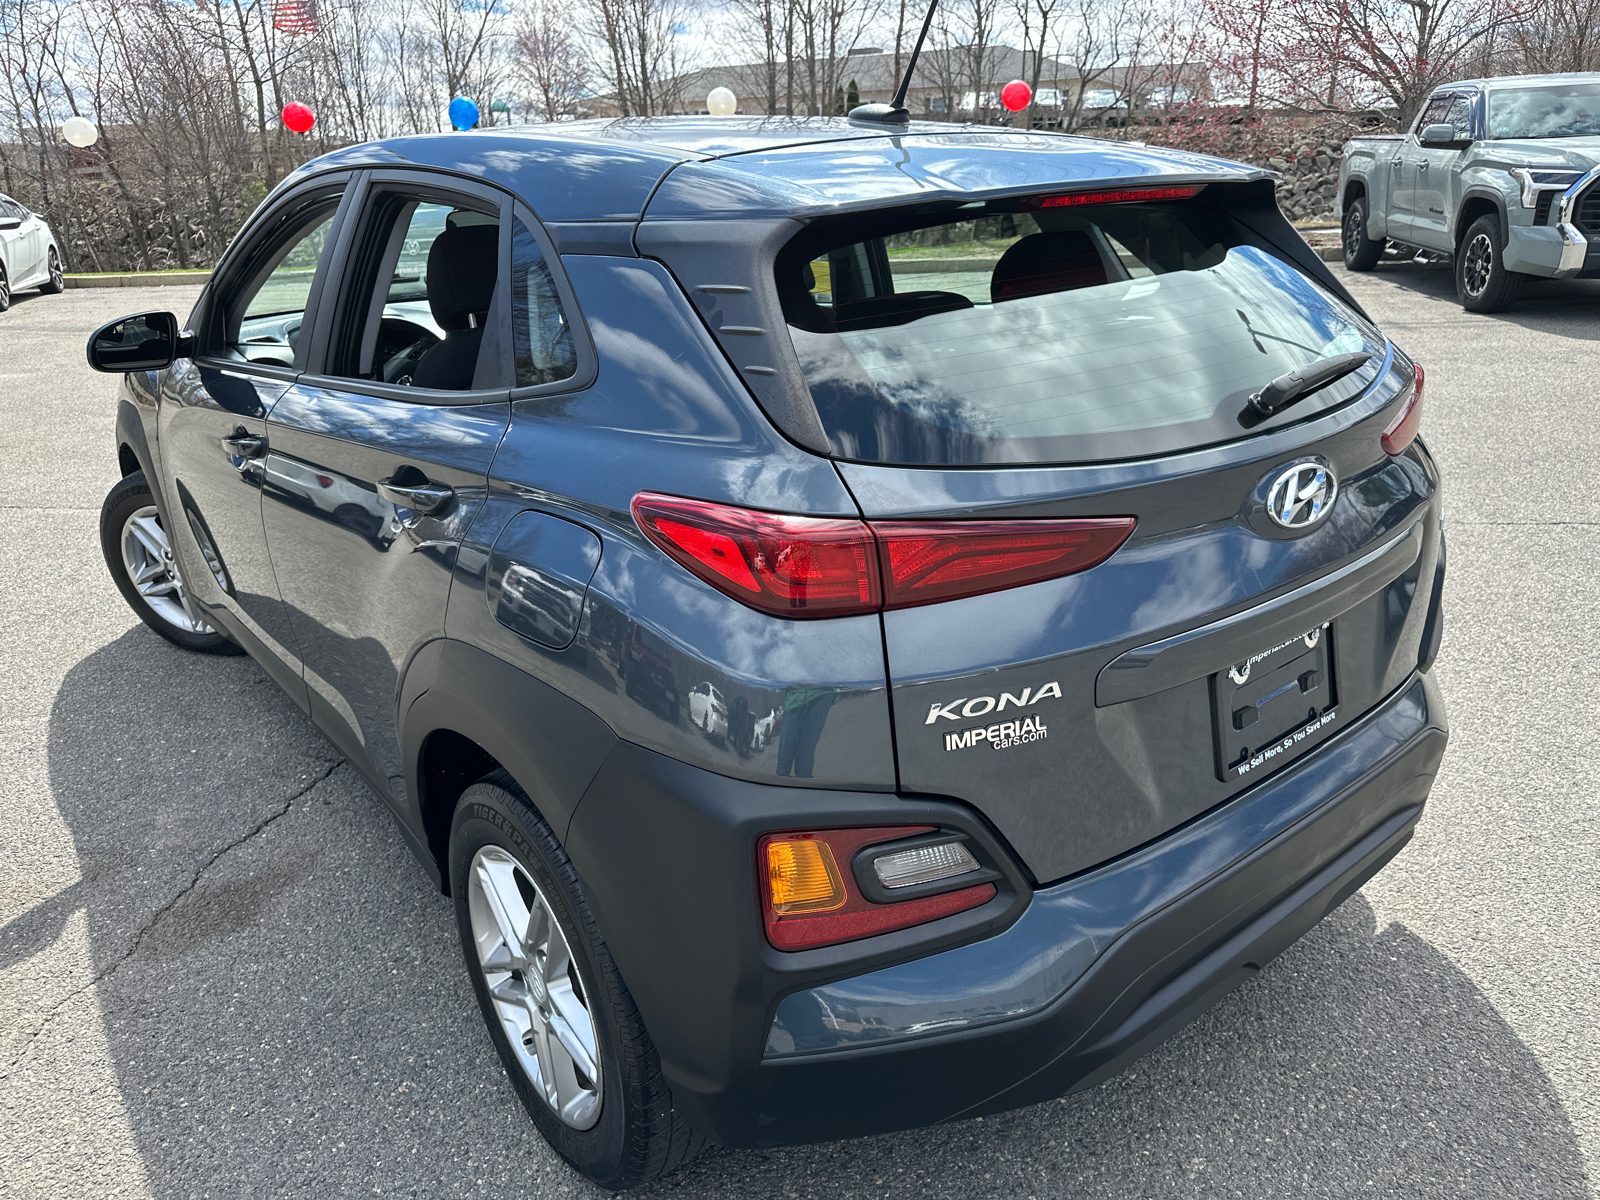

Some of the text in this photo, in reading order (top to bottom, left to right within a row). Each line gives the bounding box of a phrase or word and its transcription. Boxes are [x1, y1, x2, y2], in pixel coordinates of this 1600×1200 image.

[925, 681, 1063, 725] KONA
[944, 714, 1048, 751] IMPERIAL
[993, 728, 1048, 750] cars.com
[1237, 711, 1336, 776] We Sell More, So You Save More
[473, 805, 504, 828] TIGER
[512, 832, 542, 870] PAW
[544, 877, 569, 919] TOURING
